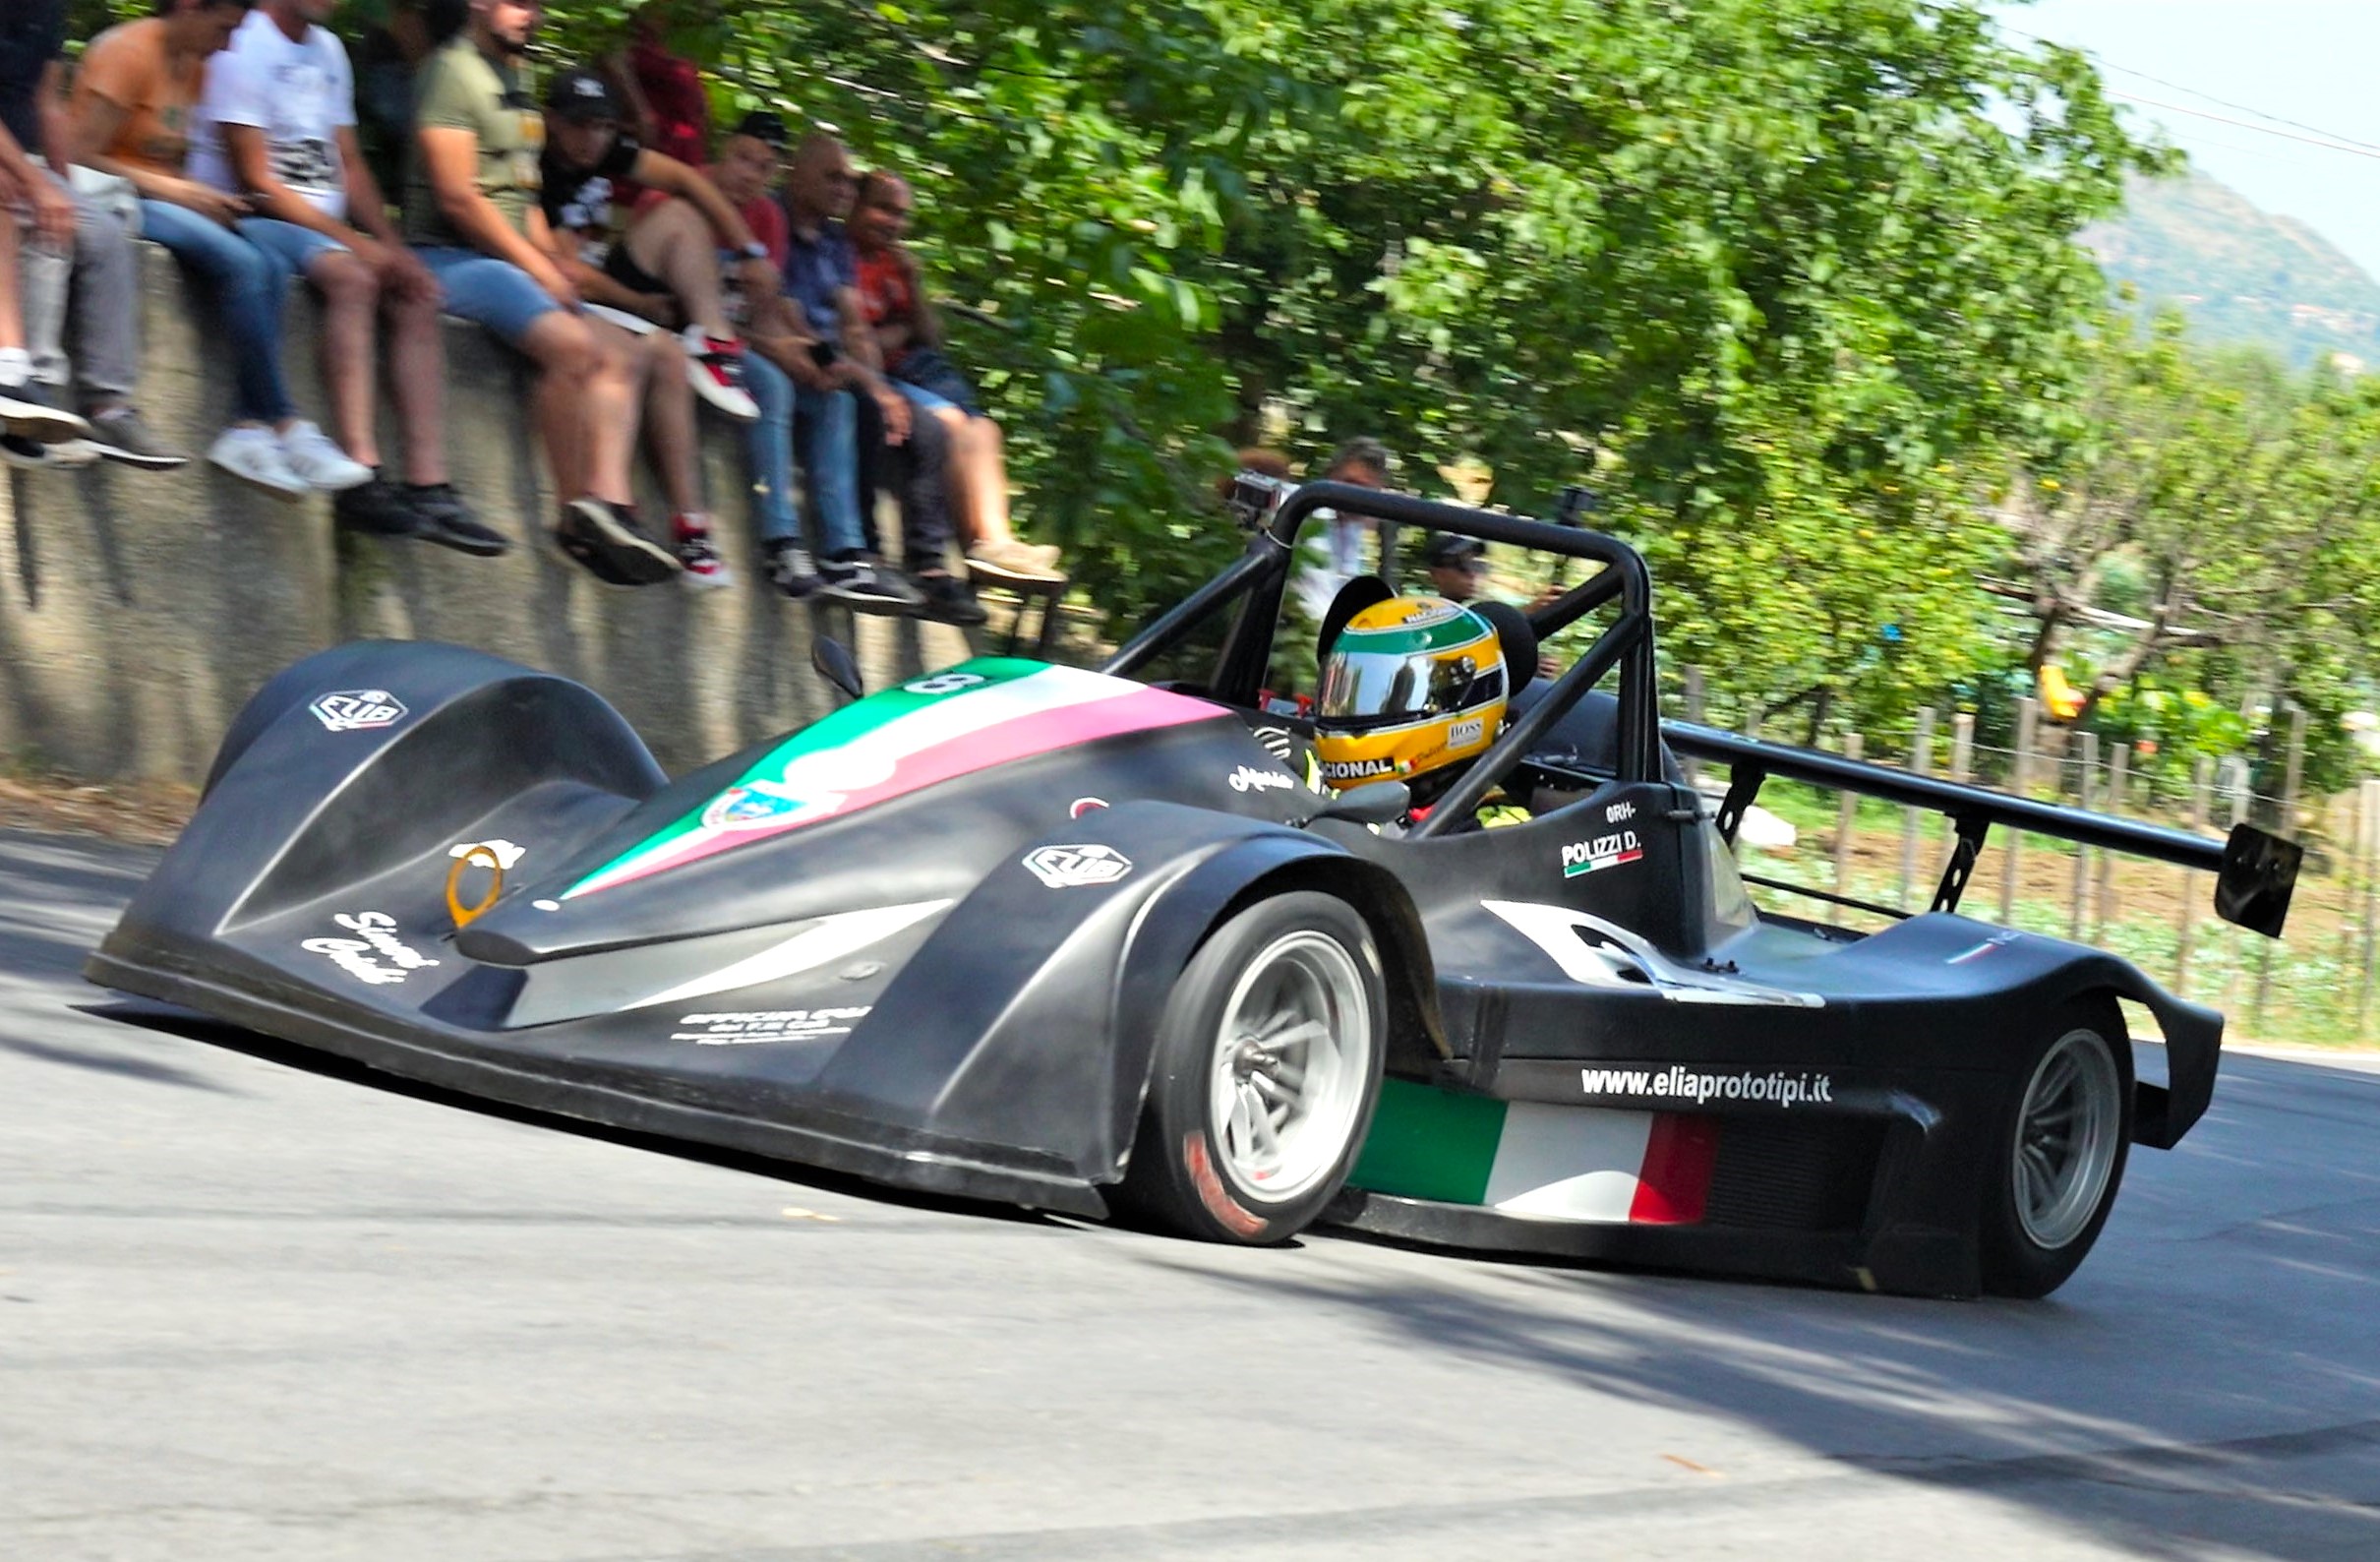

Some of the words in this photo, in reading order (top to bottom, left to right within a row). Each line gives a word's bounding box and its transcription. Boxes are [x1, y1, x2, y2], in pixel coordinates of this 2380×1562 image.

[1561, 833, 1623, 867] POLIZZI
[1624, 830, 1641, 851] D.
[1580, 1066, 1833, 1108] www.eliaprototipi.it
